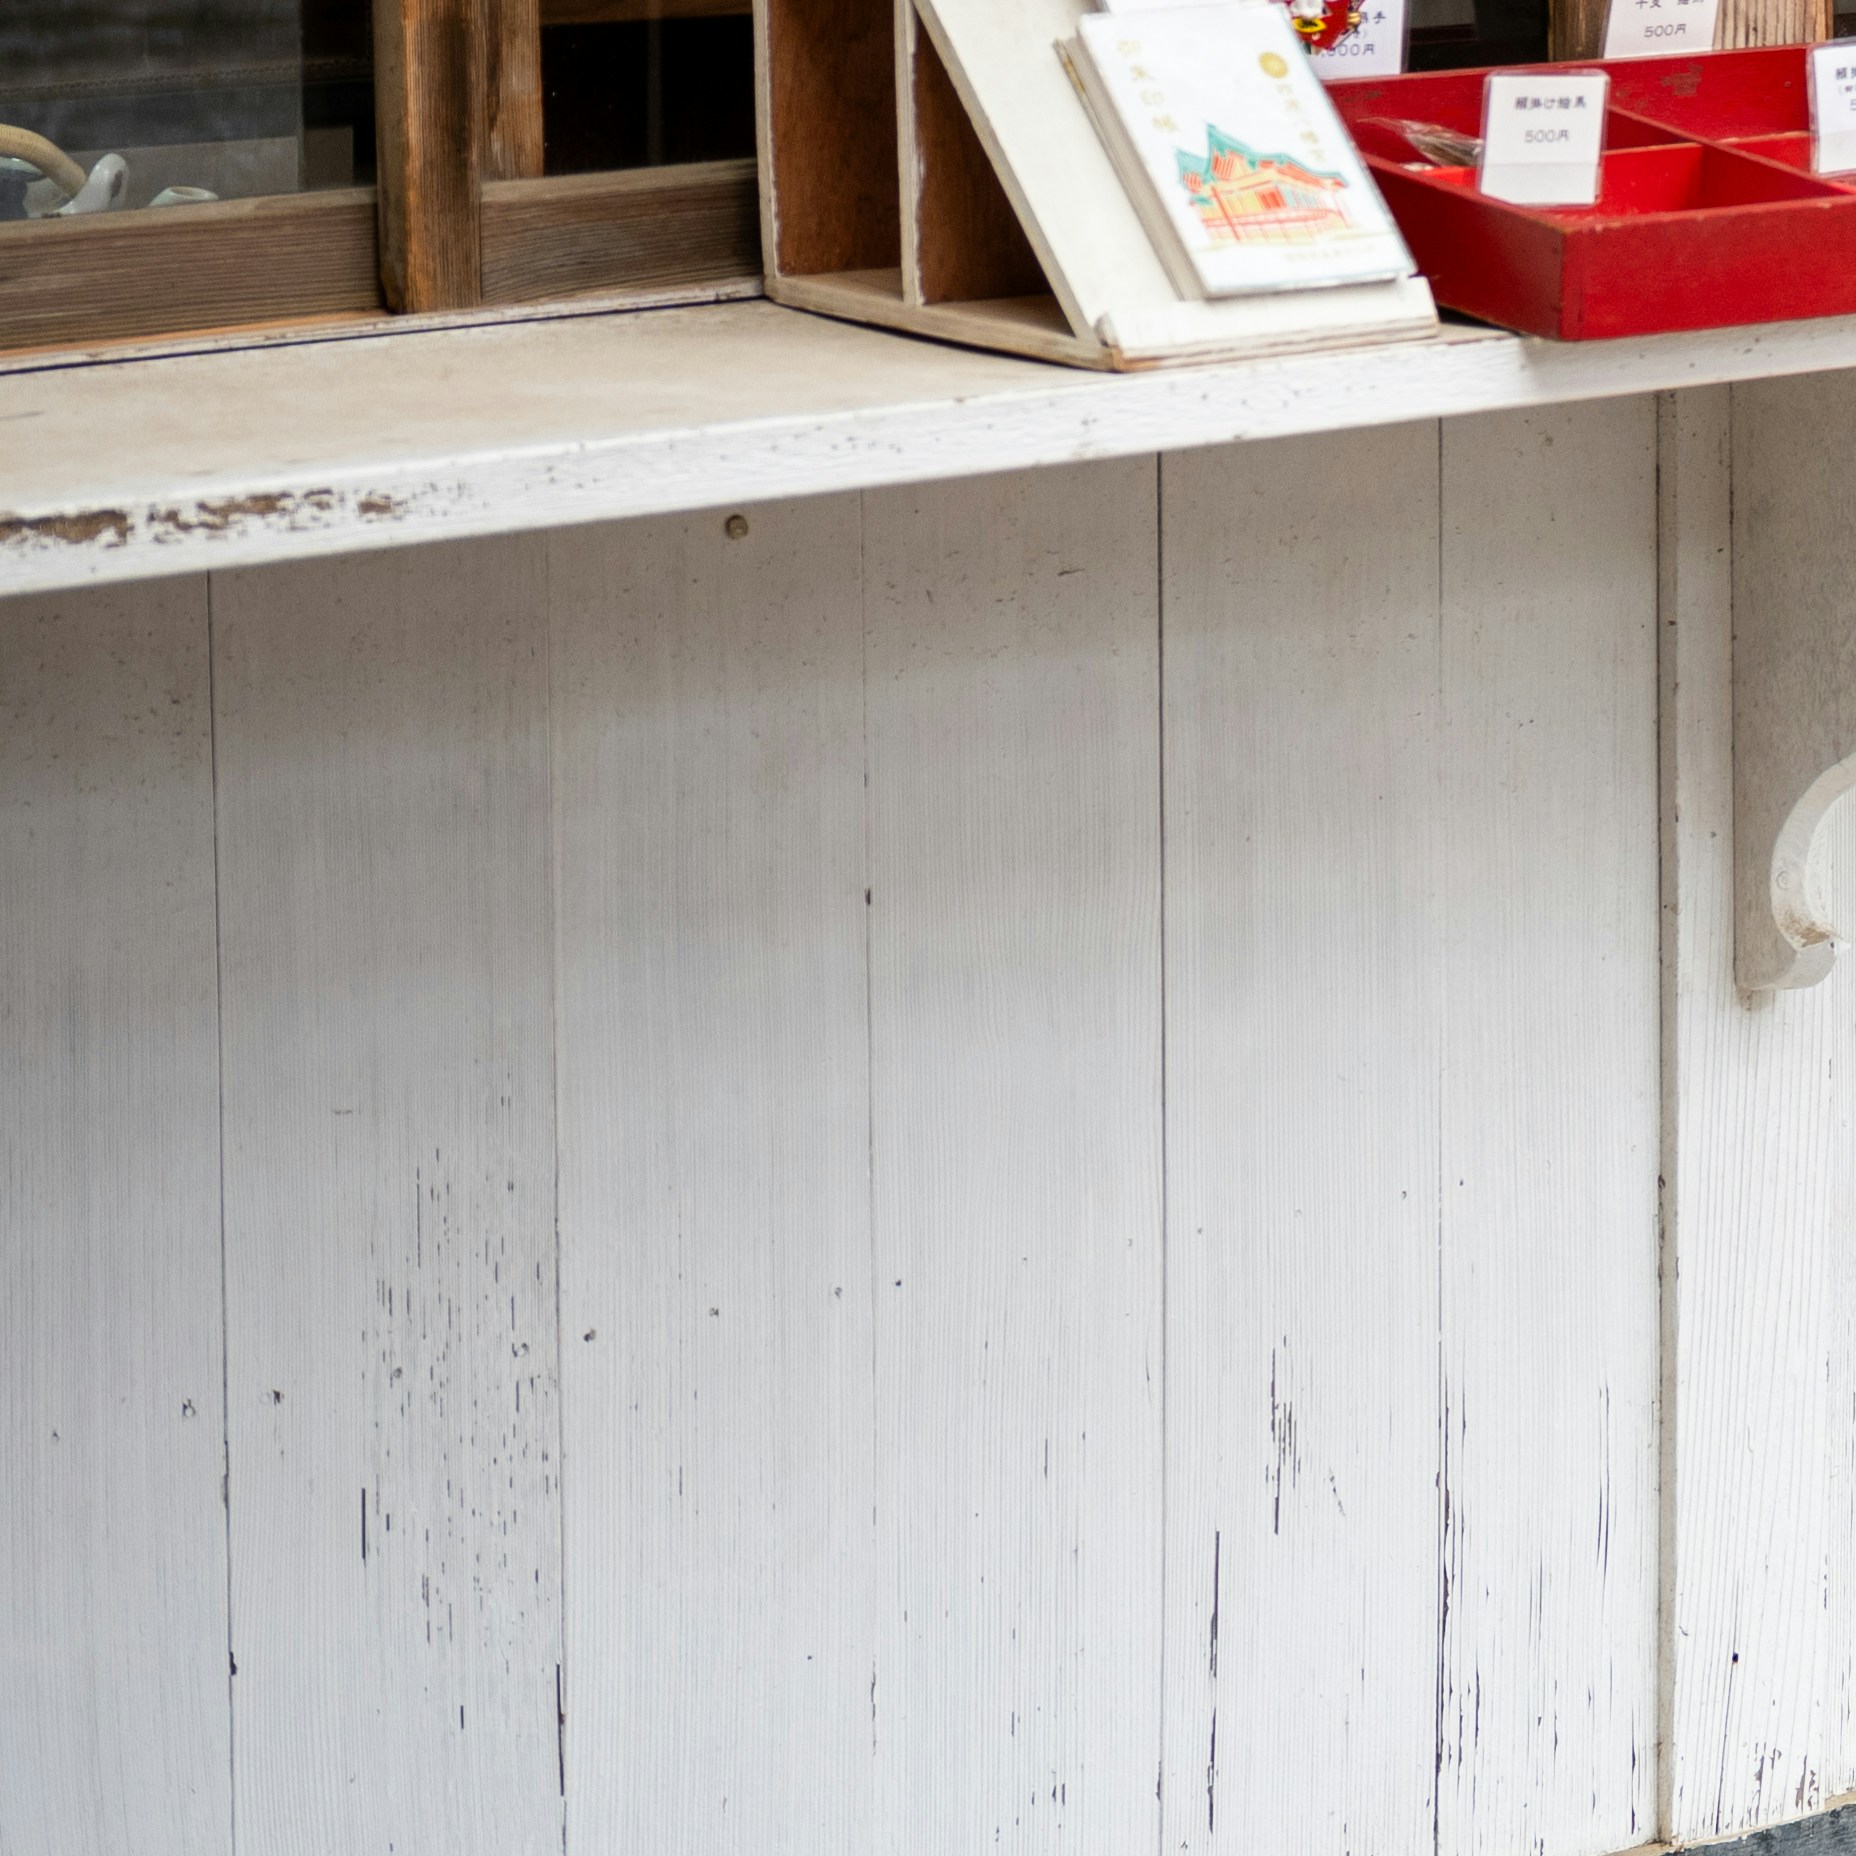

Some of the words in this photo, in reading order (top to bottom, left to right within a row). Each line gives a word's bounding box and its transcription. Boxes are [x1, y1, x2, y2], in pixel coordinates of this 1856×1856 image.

[1644, 23, 1687, 38] 500円
[1514, 95, 1587, 110] 願掛け絵馬
[1525, 129, 1570, 144] 500円
